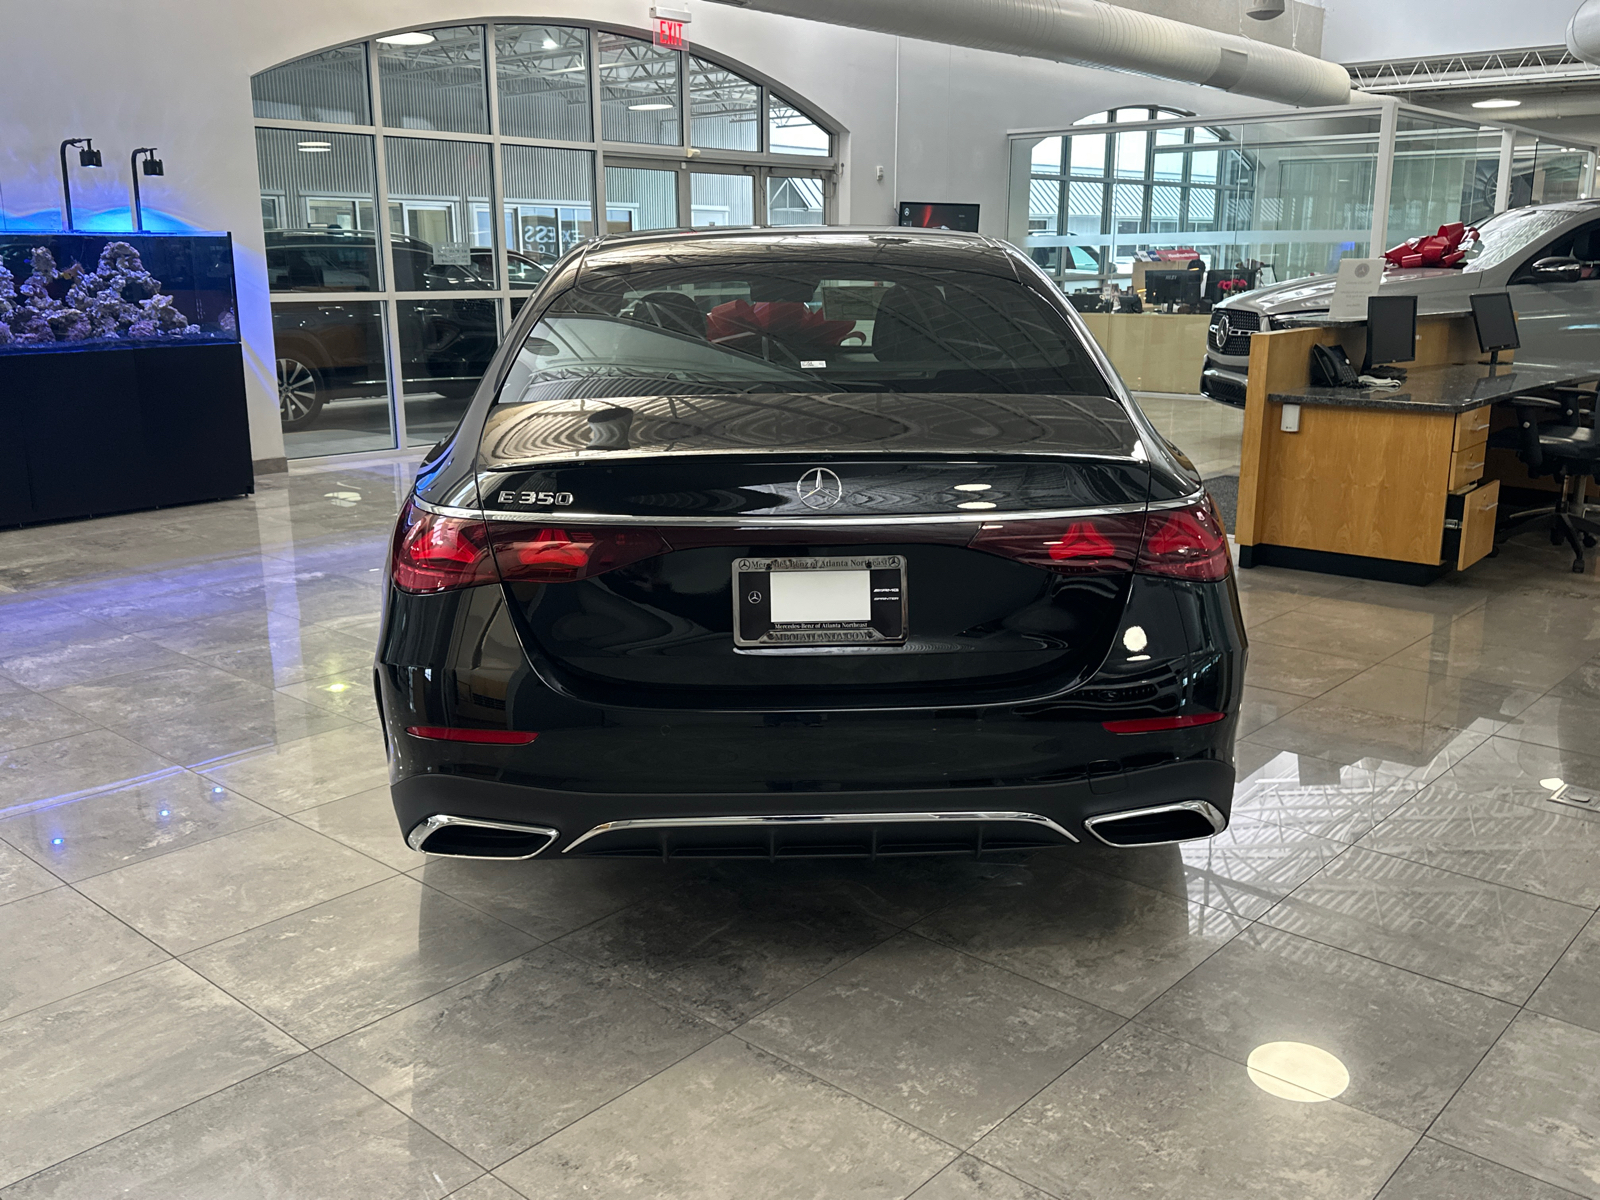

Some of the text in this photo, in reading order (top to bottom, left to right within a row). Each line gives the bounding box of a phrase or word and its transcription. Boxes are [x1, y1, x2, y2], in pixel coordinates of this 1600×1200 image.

[660, 21, 683, 46] EXIT
[498, 490, 574, 506] E 350
[751, 560, 809, 569] Meredes-Benz
[810, 559, 818, 569] of
[820, 558, 849, 568] Atlanta
